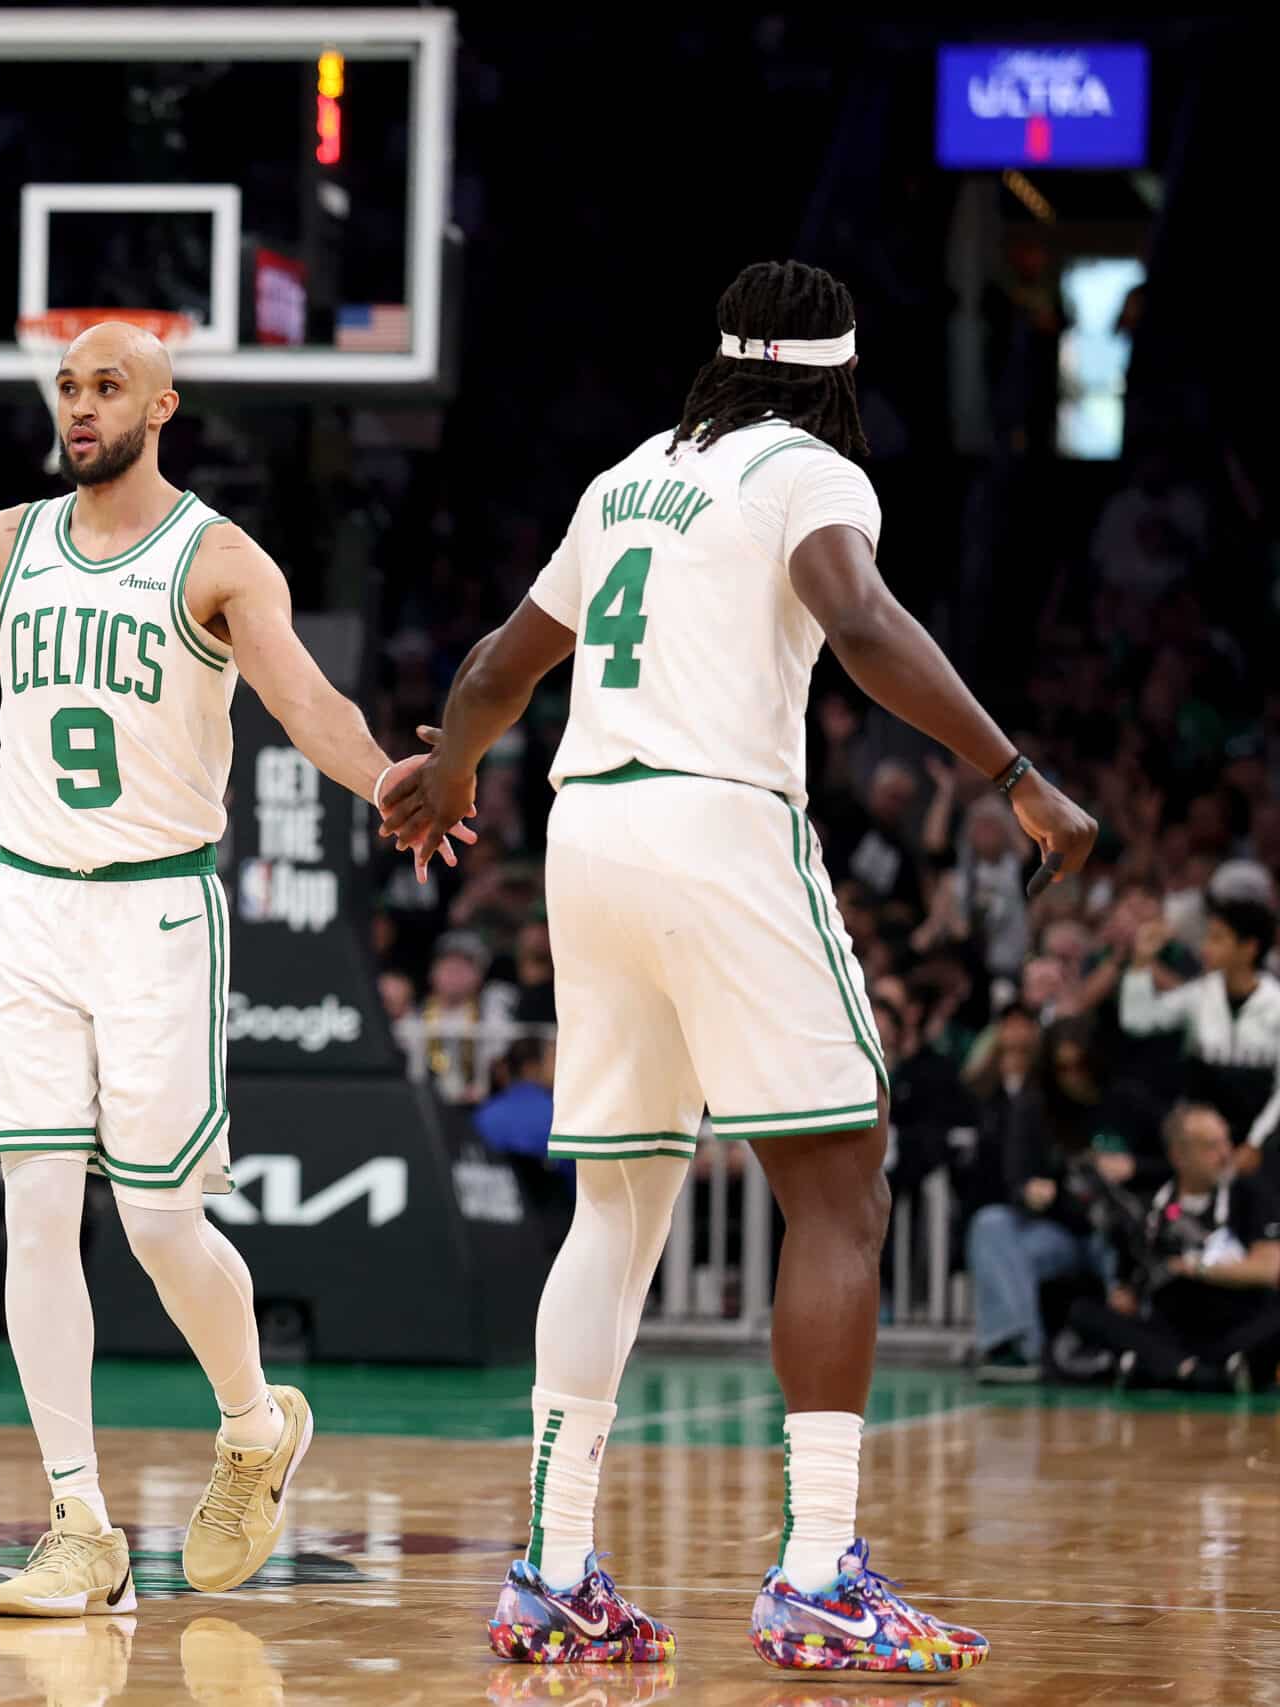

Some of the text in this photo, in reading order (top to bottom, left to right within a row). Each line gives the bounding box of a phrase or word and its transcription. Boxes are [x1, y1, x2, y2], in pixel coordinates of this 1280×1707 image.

[602, 479, 713, 535] HOLIDAY
[120, 574, 166, 591] Amica
[584, 547, 653, 689] 4
[11, 606, 167, 704] CELTICS
[50, 707, 122, 809] 9
